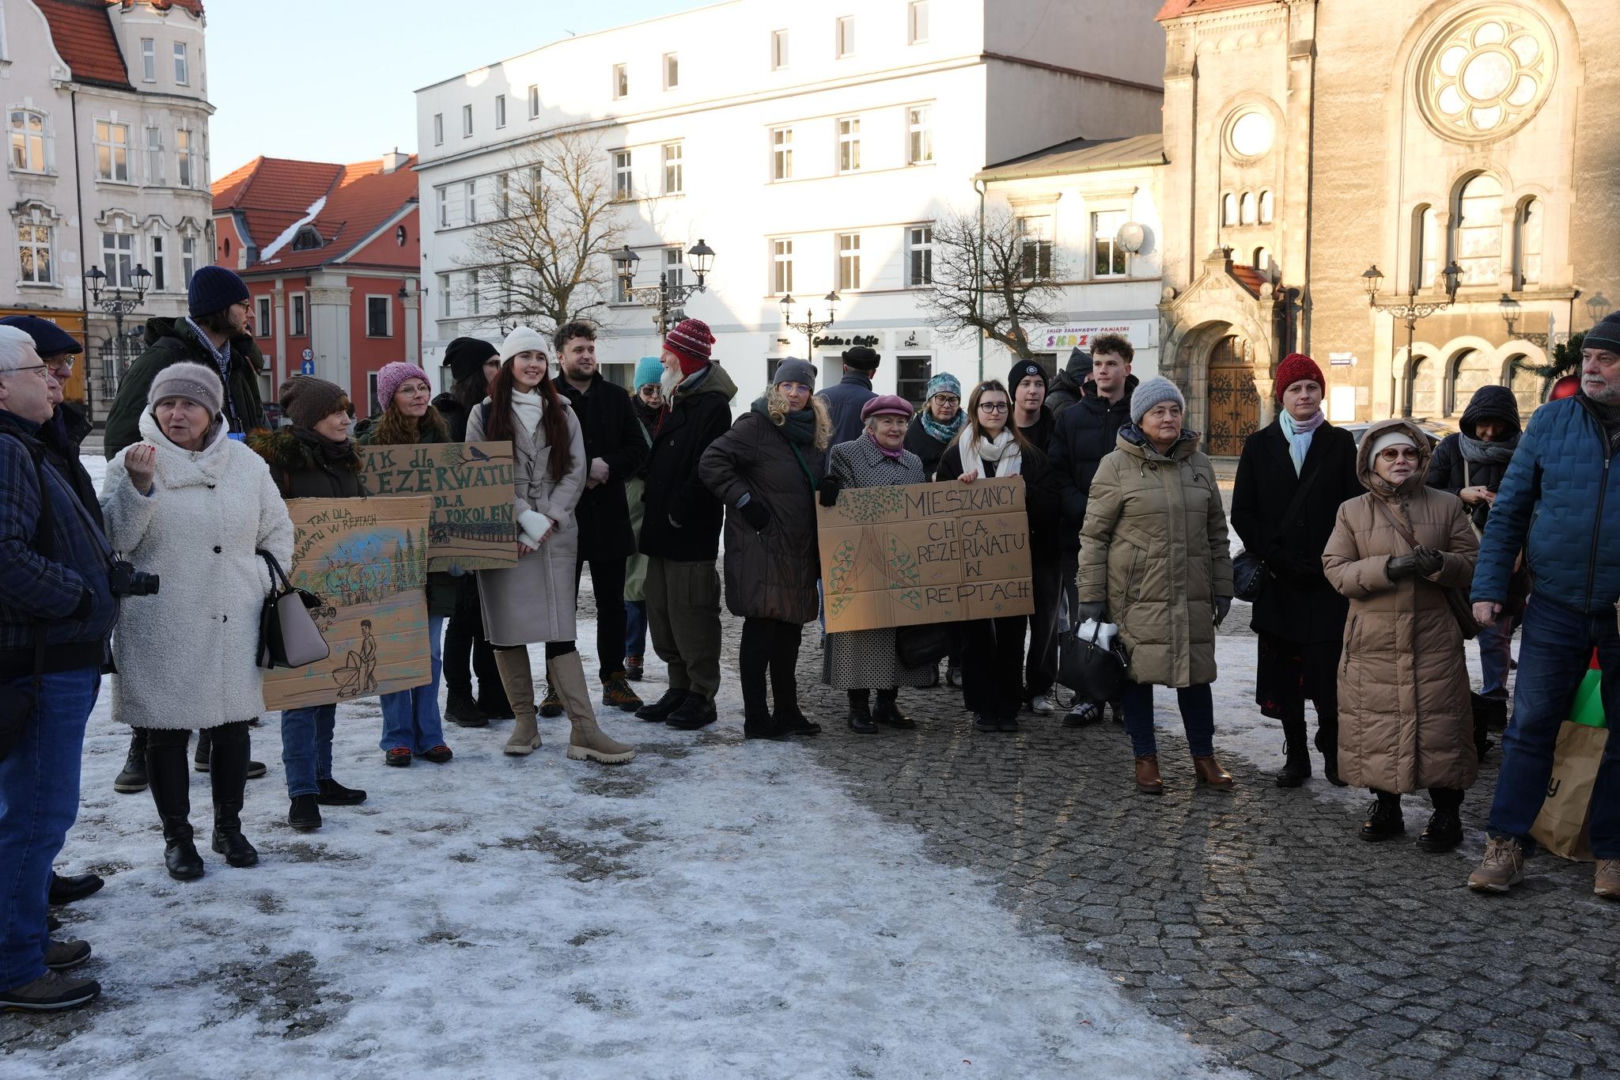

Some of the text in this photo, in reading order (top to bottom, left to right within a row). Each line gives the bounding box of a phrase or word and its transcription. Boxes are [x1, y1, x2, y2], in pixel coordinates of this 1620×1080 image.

[409, 448, 434, 469] dla
[433, 494, 464, 508] DLA
[904, 485, 1017, 519] MIESZKAŃCY
[444, 502, 514, 524] POKOLEŃ
[327, 523, 340, 534] W
[917, 533, 1025, 565] REZERWATU
[965, 560, 983, 577] W
